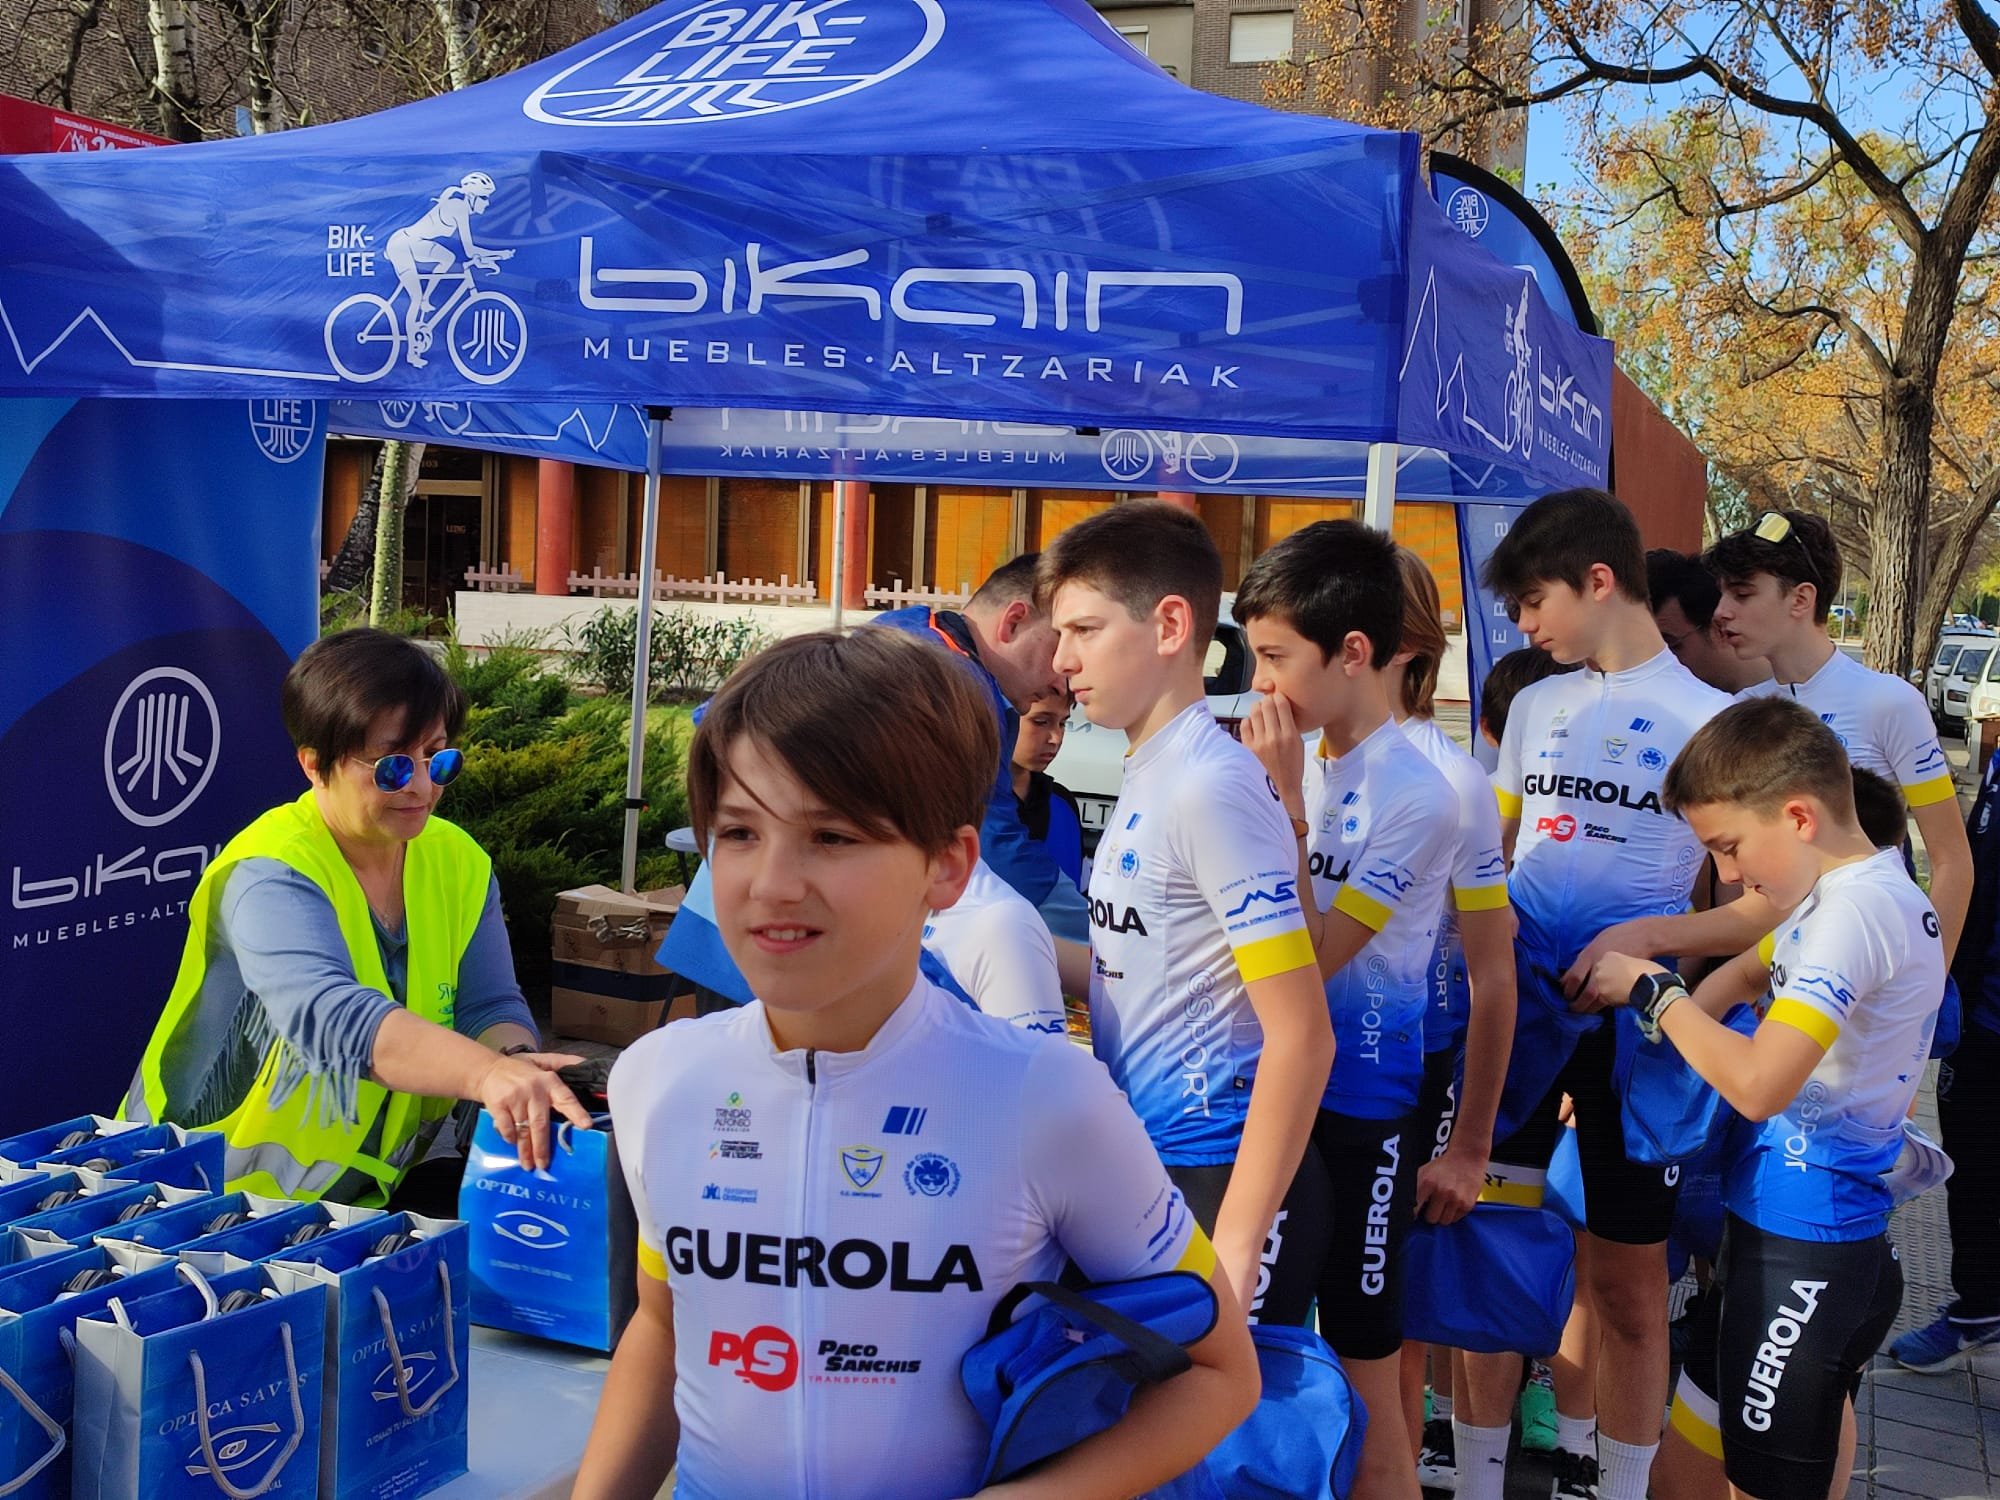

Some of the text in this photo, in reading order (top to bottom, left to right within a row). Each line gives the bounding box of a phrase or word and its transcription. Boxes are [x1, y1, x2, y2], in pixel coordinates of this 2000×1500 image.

[662, 0, 866, 49] BIK-
[614, 37, 857, 86] LIFE
[327, 225, 374, 249] BIK-
[327, 251, 375, 277] LIFE
[1081, 801, 1117, 825] LT
[1524, 774, 1663, 815] GUEROLA
[1360, 954, 1389, 1065] GSPORT
[1180, 969, 1217, 1118] GSPORT
[475, 1178, 592, 1210] OPTICA SAVIS
[1361, 1133, 1400, 1296] GUEROLA
[666, 1226, 984, 1293] GUEROLA
[825, 1356, 921, 1373] SANCHIS
[1742, 1279, 1829, 1432] GUEROLA
[808, 1375, 897, 1385] TRANSPORTS
[159, 1399, 233, 1436] OPTCA
